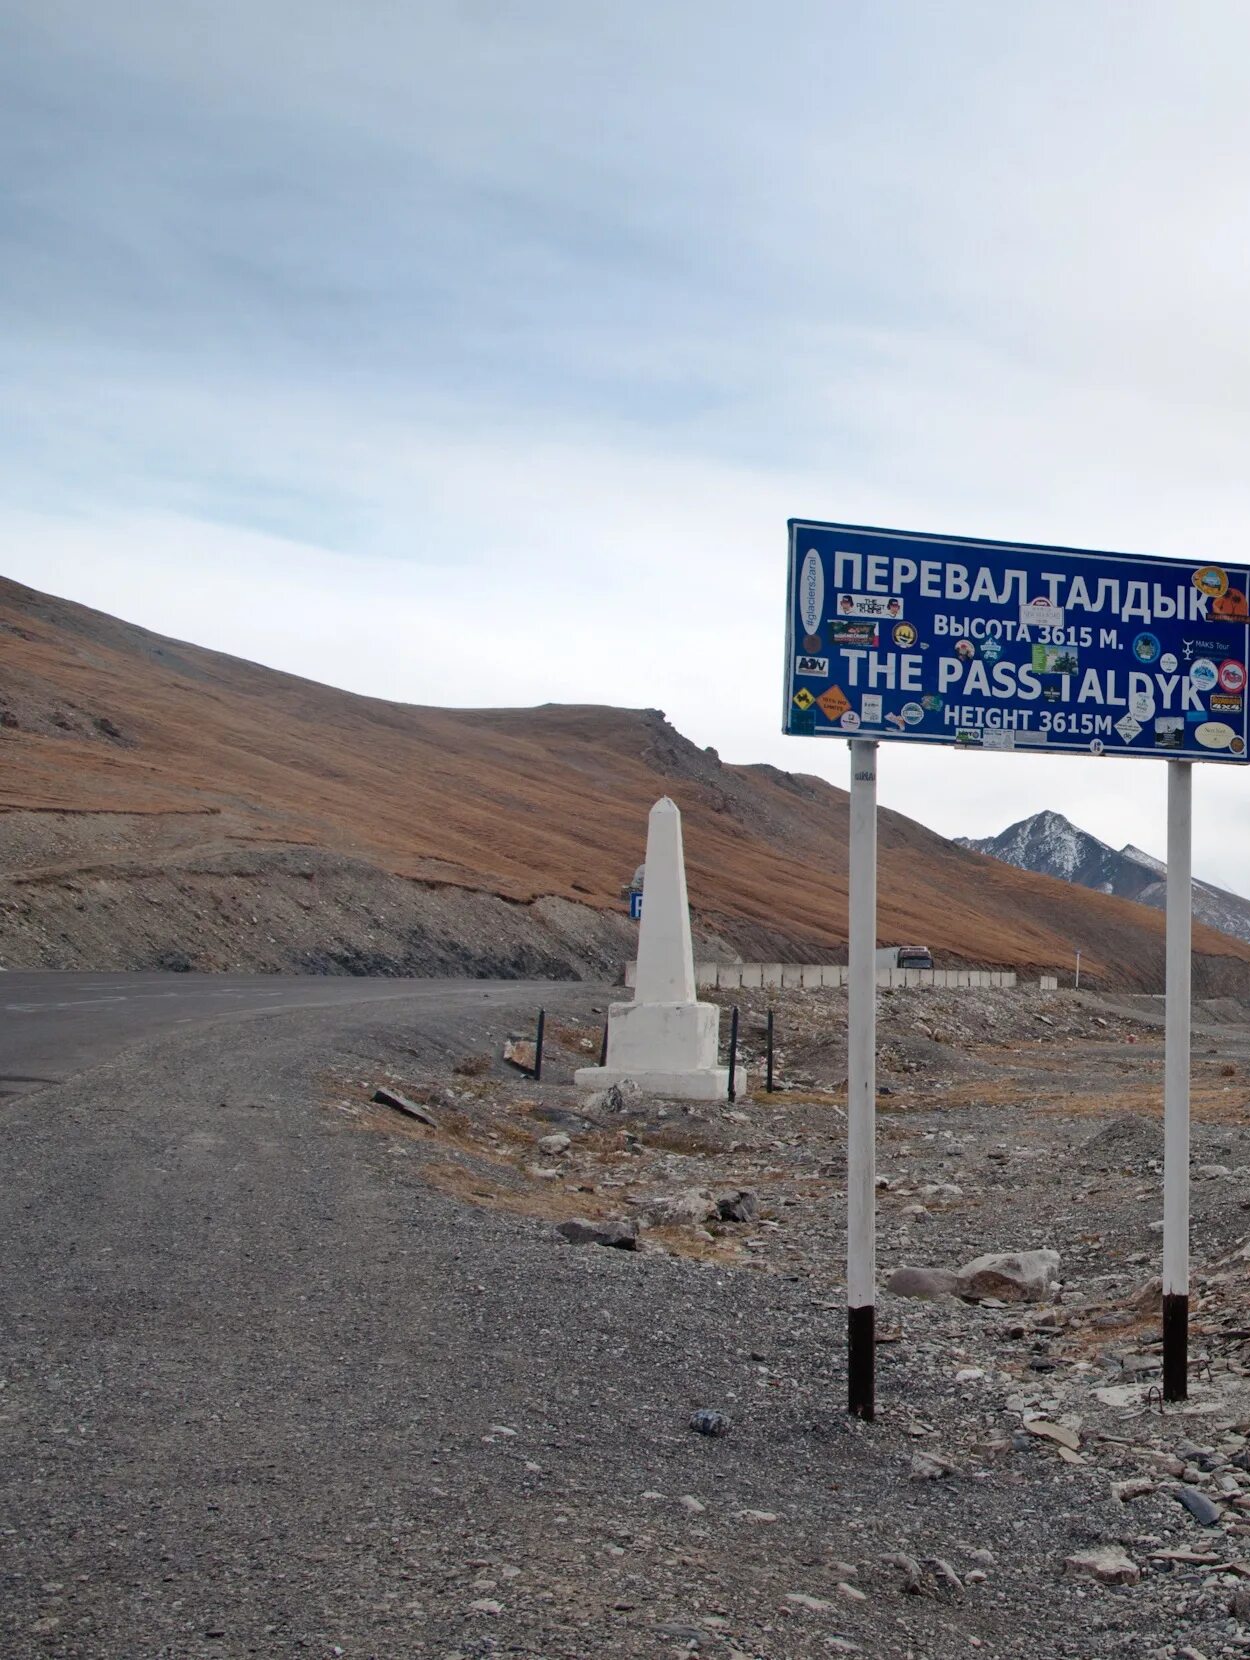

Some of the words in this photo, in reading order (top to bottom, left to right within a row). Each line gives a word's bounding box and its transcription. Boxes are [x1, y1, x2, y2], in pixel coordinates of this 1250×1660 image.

[806, 556, 818, 626] #glaciers2aral
[834, 551, 1027, 604] ПЕРЕВАЛ
[1041, 573, 1213, 624] ТАЛДЫК
[934, 614, 1031, 642] ВЫСОТА
[1038, 625, 1093, 648] 3615
[1195, 640, 1214, 649] MAKS
[1216, 642, 1231, 650] Tour
[840, 648, 923, 692] THE
[938, 656, 1042, 700] PASS
[944, 704, 1033, 731] HEIGHT
[1039, 710, 1112, 735] 3615M
